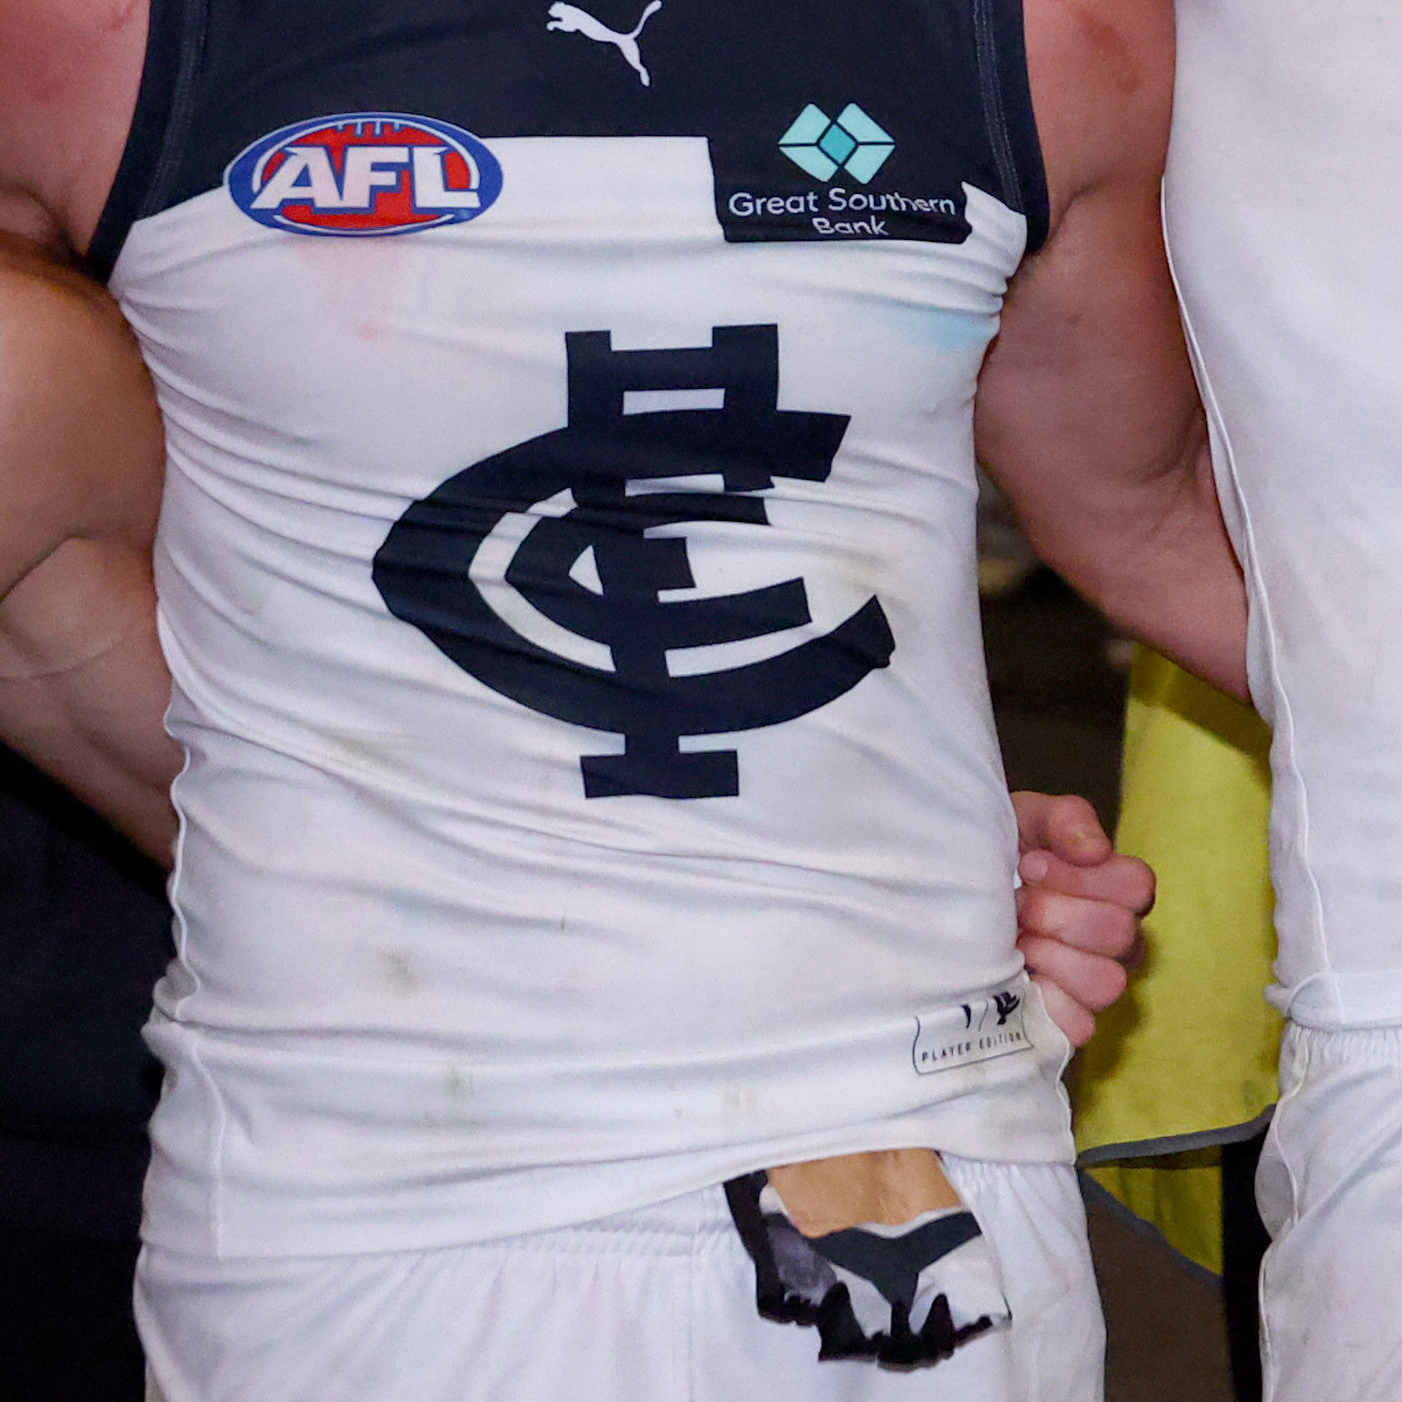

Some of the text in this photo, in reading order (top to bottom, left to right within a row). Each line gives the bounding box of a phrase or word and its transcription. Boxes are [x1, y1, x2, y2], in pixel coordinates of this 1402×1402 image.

[251, 144, 481, 210] AFL
[728, 187, 957, 218] Great Southern
[812, 216, 890, 237] Bank
[921, 1031, 1022, 1063] PLAYER EDITION
